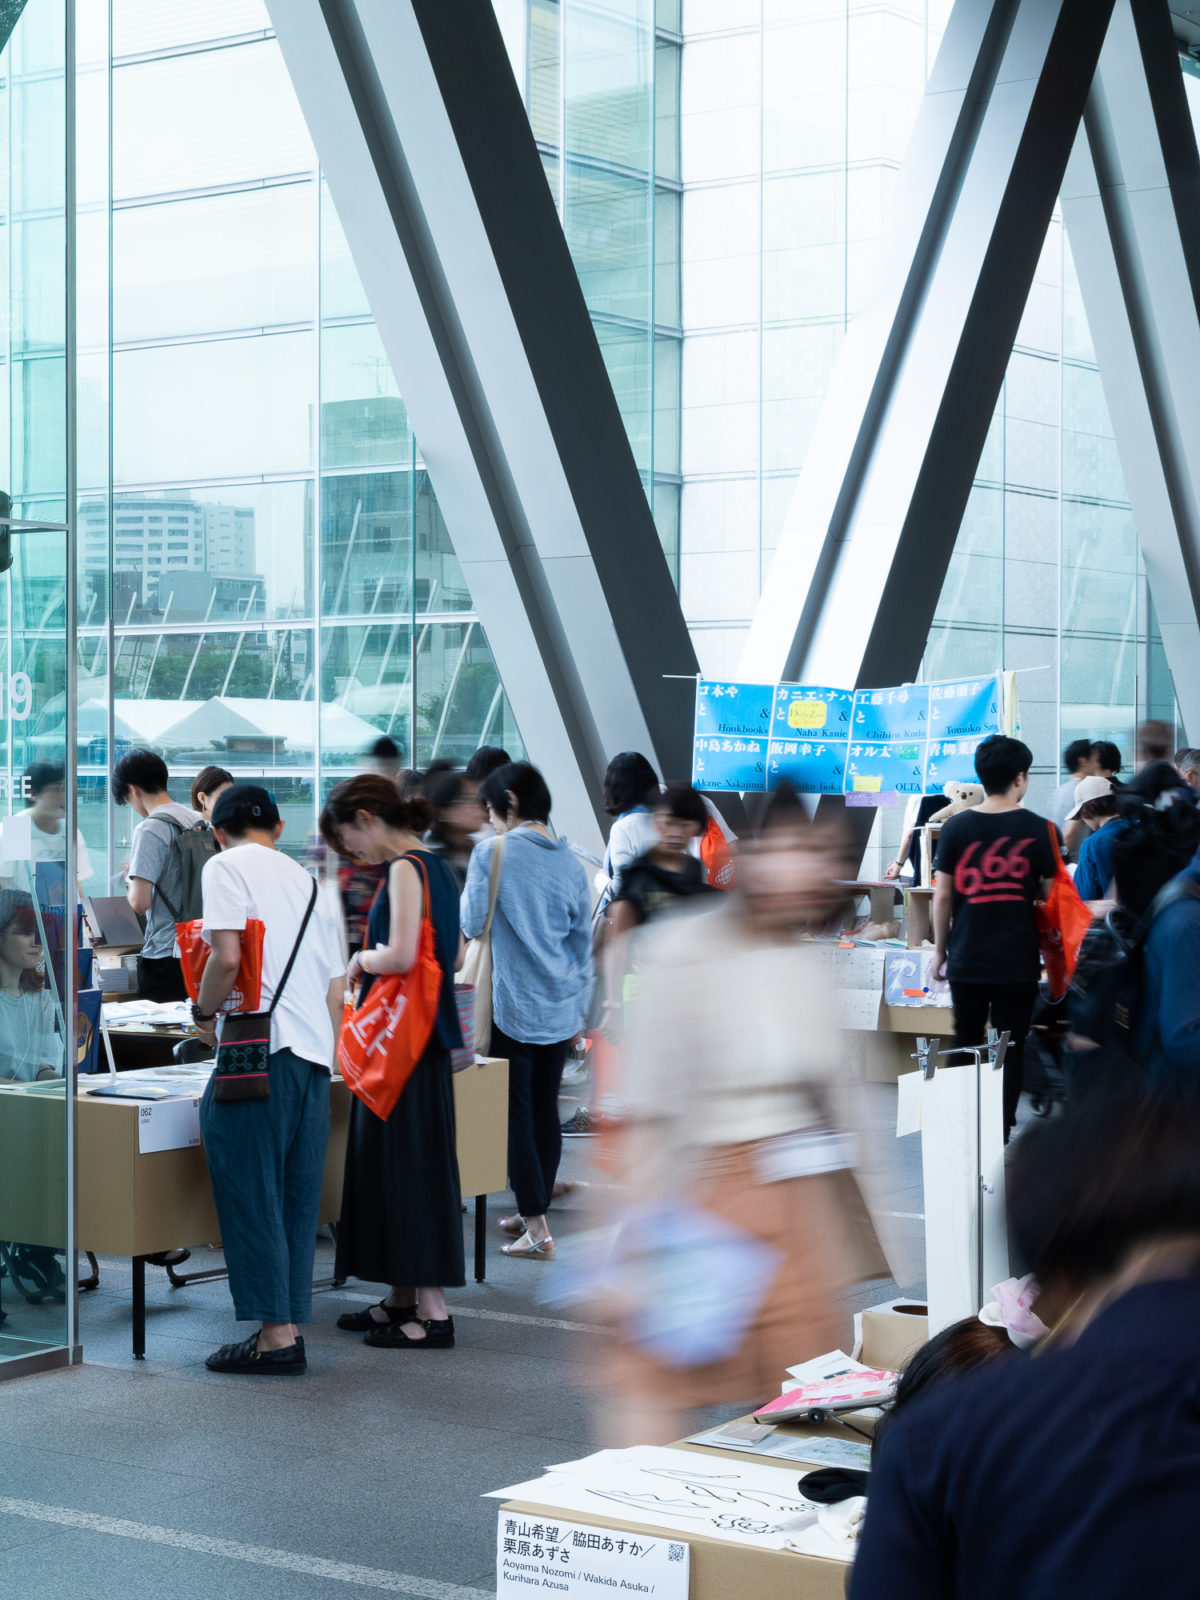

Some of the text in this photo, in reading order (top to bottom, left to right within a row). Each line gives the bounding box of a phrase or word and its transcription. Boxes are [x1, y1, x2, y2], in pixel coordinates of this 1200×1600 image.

[760, 708, 769, 719] &
[776, 707, 786, 720] と
[839, 711, 849, 722] &
[855, 711, 866, 723] と
[917, 710, 926, 721] &
[932, 708, 941, 720] と
[718, 723, 768, 734] Honkbooks
[945, 724, 981, 734] Tomoko
[696, 739, 760, 753] 中島あかね
[850, 745, 892, 758] オル太
[696, 758, 705, 771] と
[754, 762, 764, 773] &
[770, 761, 780, 773] と
[832, 765, 842, 775] &
[848, 762, 858, 776] と
[912, 765, 922, 776] &
[929, 763, 938, 776] と
[895, 782, 921, 791] OLTA
[955, 836, 1036, 895] 666
[140, 1107, 152, 1117] 062
[503, 1537, 571, 1564] 栗原あずさ
[503, 1559, 539, 1576] Aoyama
[541, 1564, 576, 1580] Nozomi
[584, 1571, 618, 1588] Wakida
[620, 1577, 649, 1593] Asuka
[503, 1572, 569, 1592] Kurihara Azusa
